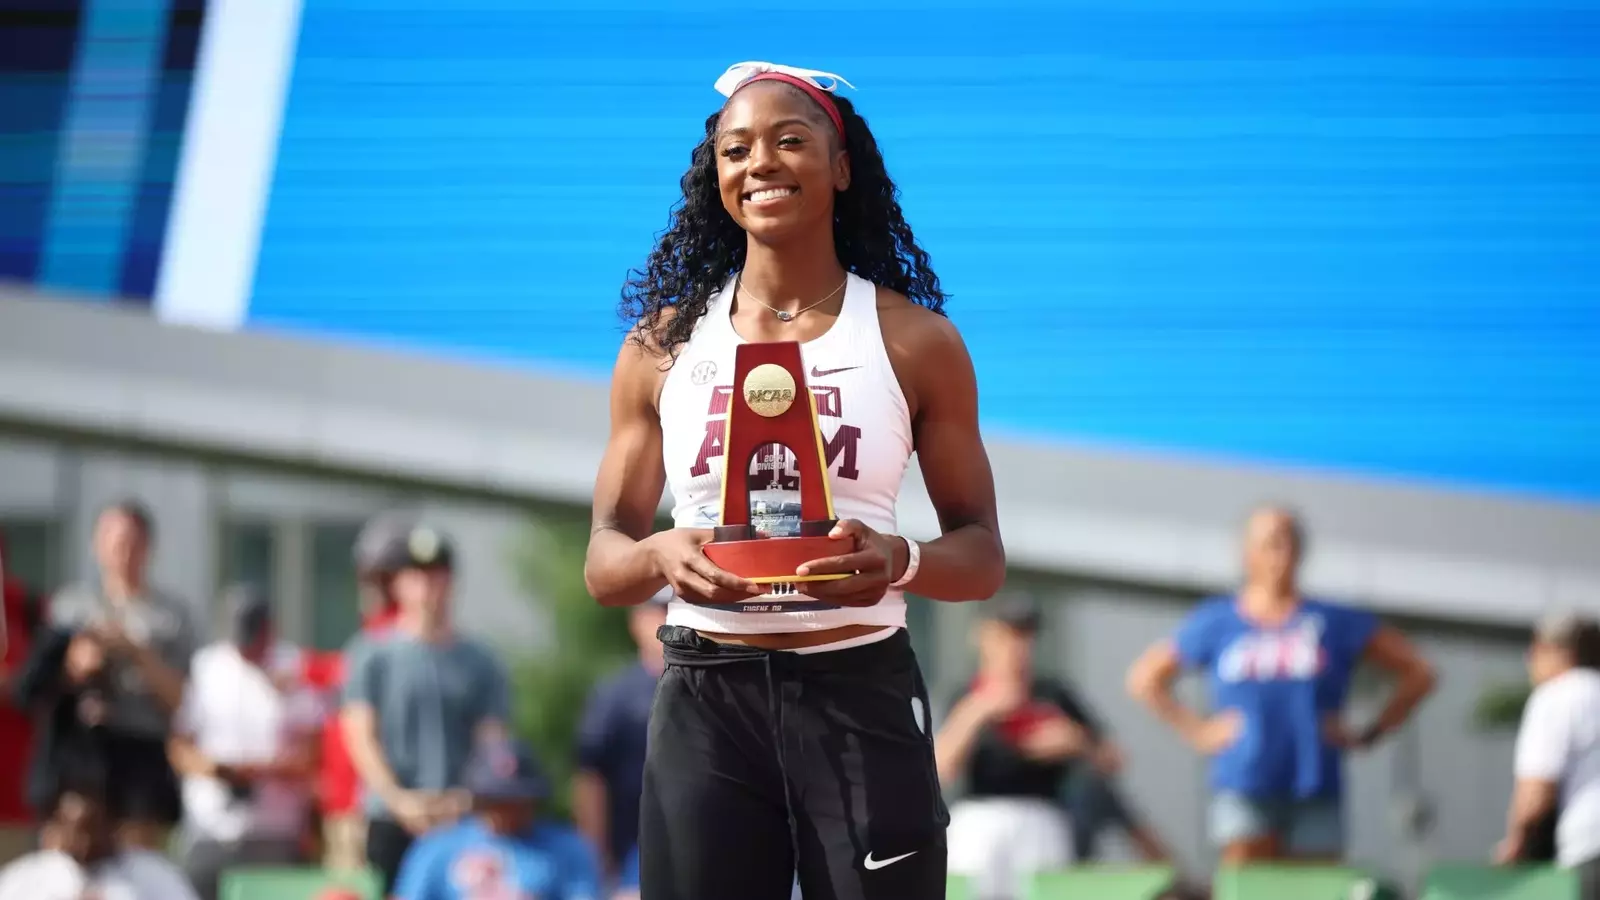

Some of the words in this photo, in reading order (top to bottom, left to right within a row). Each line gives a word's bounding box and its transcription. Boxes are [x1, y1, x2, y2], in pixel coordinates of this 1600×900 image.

[748, 388, 793, 403] NCAA
[764, 454, 784, 463] 204
[757, 462, 787, 470] DIVISON
